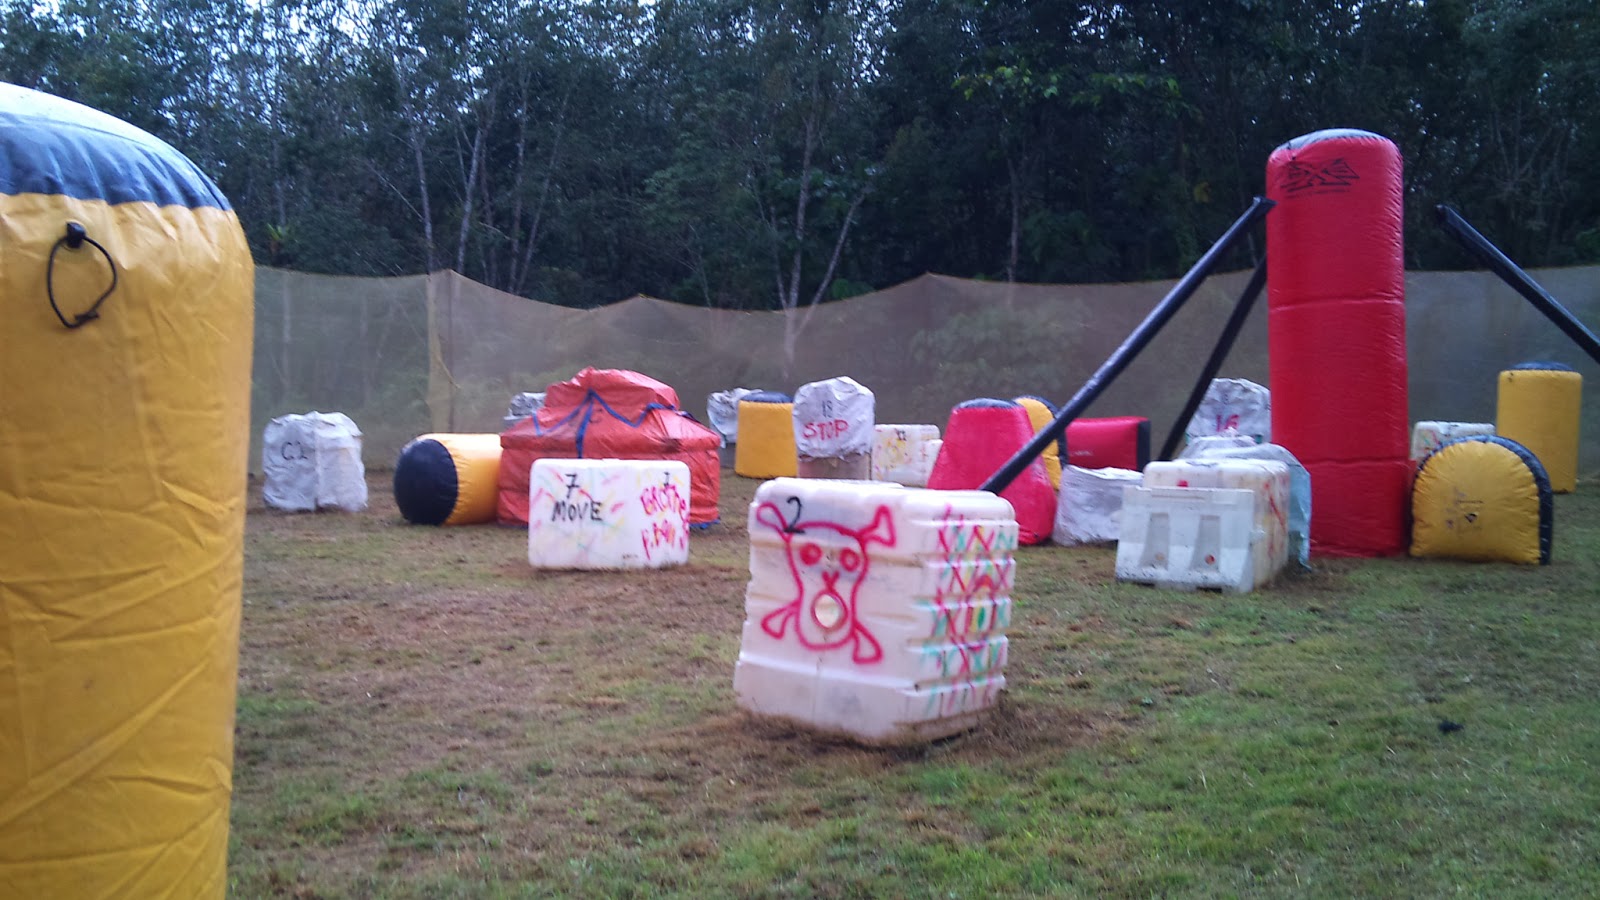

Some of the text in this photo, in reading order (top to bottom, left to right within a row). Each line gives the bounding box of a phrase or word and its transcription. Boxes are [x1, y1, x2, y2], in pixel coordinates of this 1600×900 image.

[803, 418, 848, 441] STOP
[565, 473, 580, 498] 7
[552, 500, 603, 522] MOVE
[783, 496, 806, 534] 2
